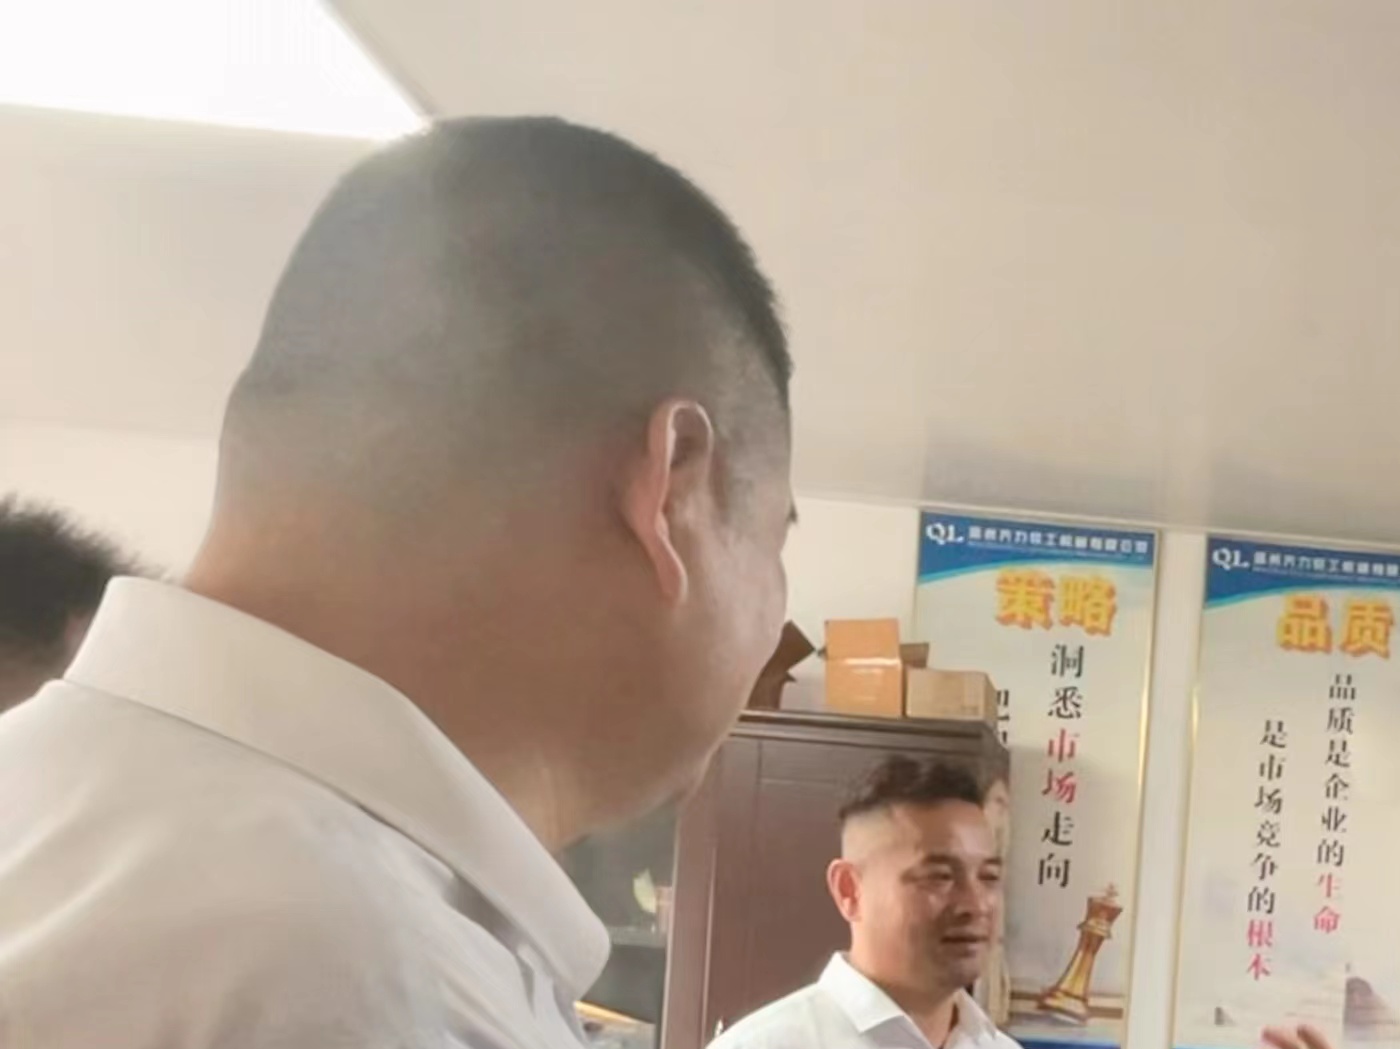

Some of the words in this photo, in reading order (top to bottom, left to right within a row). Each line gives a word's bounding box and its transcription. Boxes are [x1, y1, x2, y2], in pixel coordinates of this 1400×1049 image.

[994, 568, 1118, 637] 策略
[1277, 592, 1397, 660] 品质
[1037, 645, 1084, 888] 洞悉市场走向
[1246, 719, 1287, 981] 是市场竞争的根本
[1313, 673, 1356, 934] 品质是企业的生命
